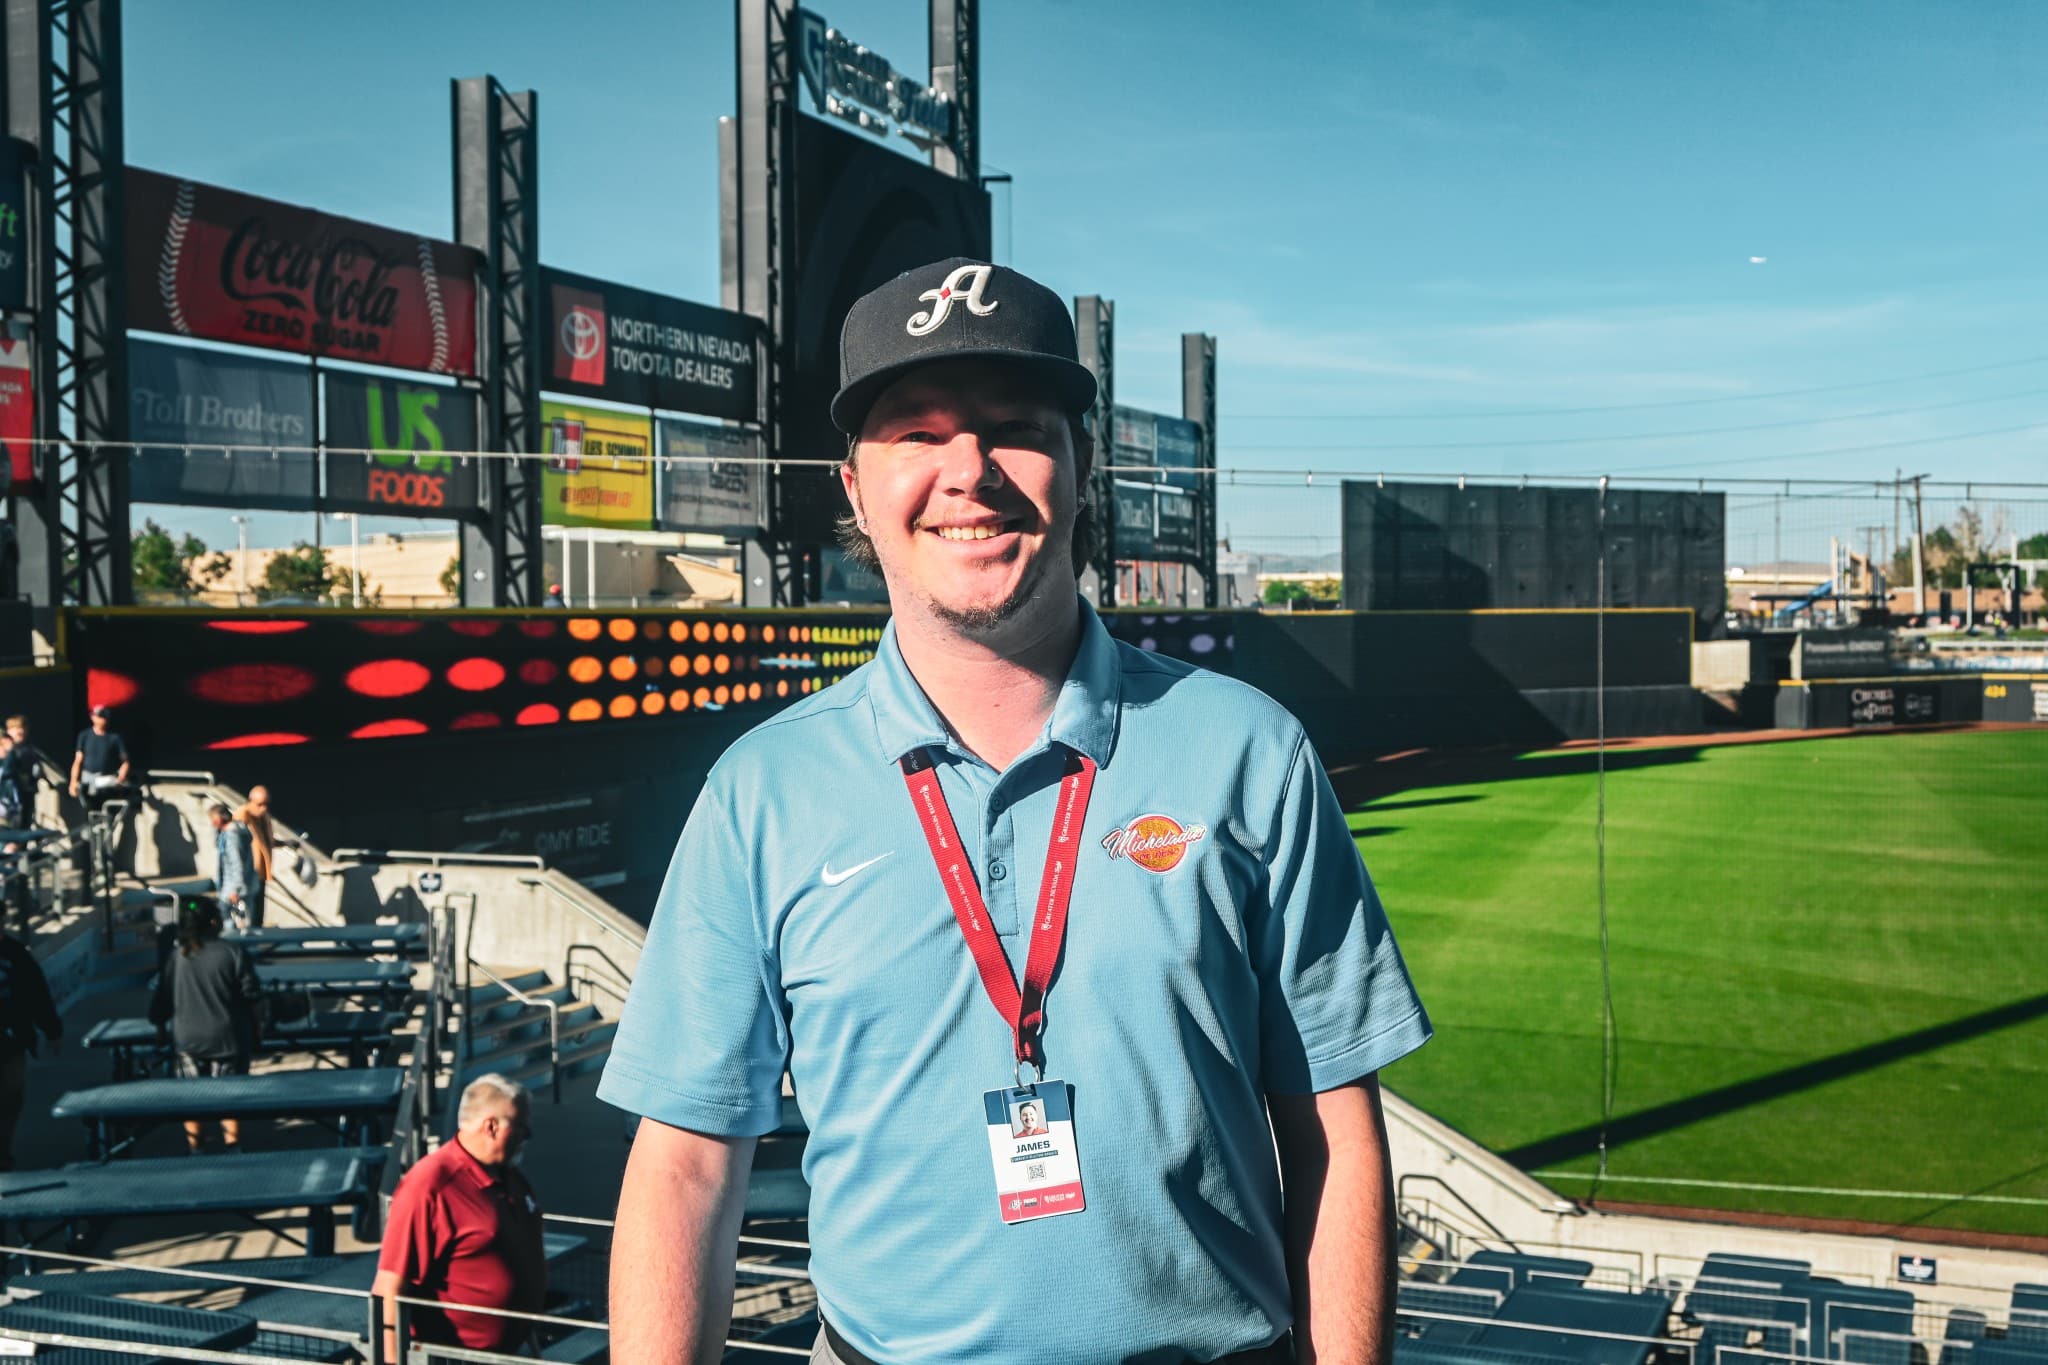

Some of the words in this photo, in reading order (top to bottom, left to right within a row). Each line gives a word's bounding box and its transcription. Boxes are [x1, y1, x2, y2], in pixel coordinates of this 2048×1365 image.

[906, 264, 998, 337] A
[244, 309, 304, 339] ZERO
[312, 322, 381, 352] SUGAR
[611, 316, 695, 352] NORTHERN
[698, 334, 751, 365] NEVADA
[612, 345, 672, 377] TOYOTA
[674, 360, 733, 390] DEALERS
[133, 388, 193, 425] Toll
[199, 395, 305, 436] Brothers
[369, 471, 445, 507] FOODS
[576, 820, 610, 849] RIDE
[1101, 824, 1207, 861] Micheladas
[1016, 1141, 1050, 1154] JAMES
